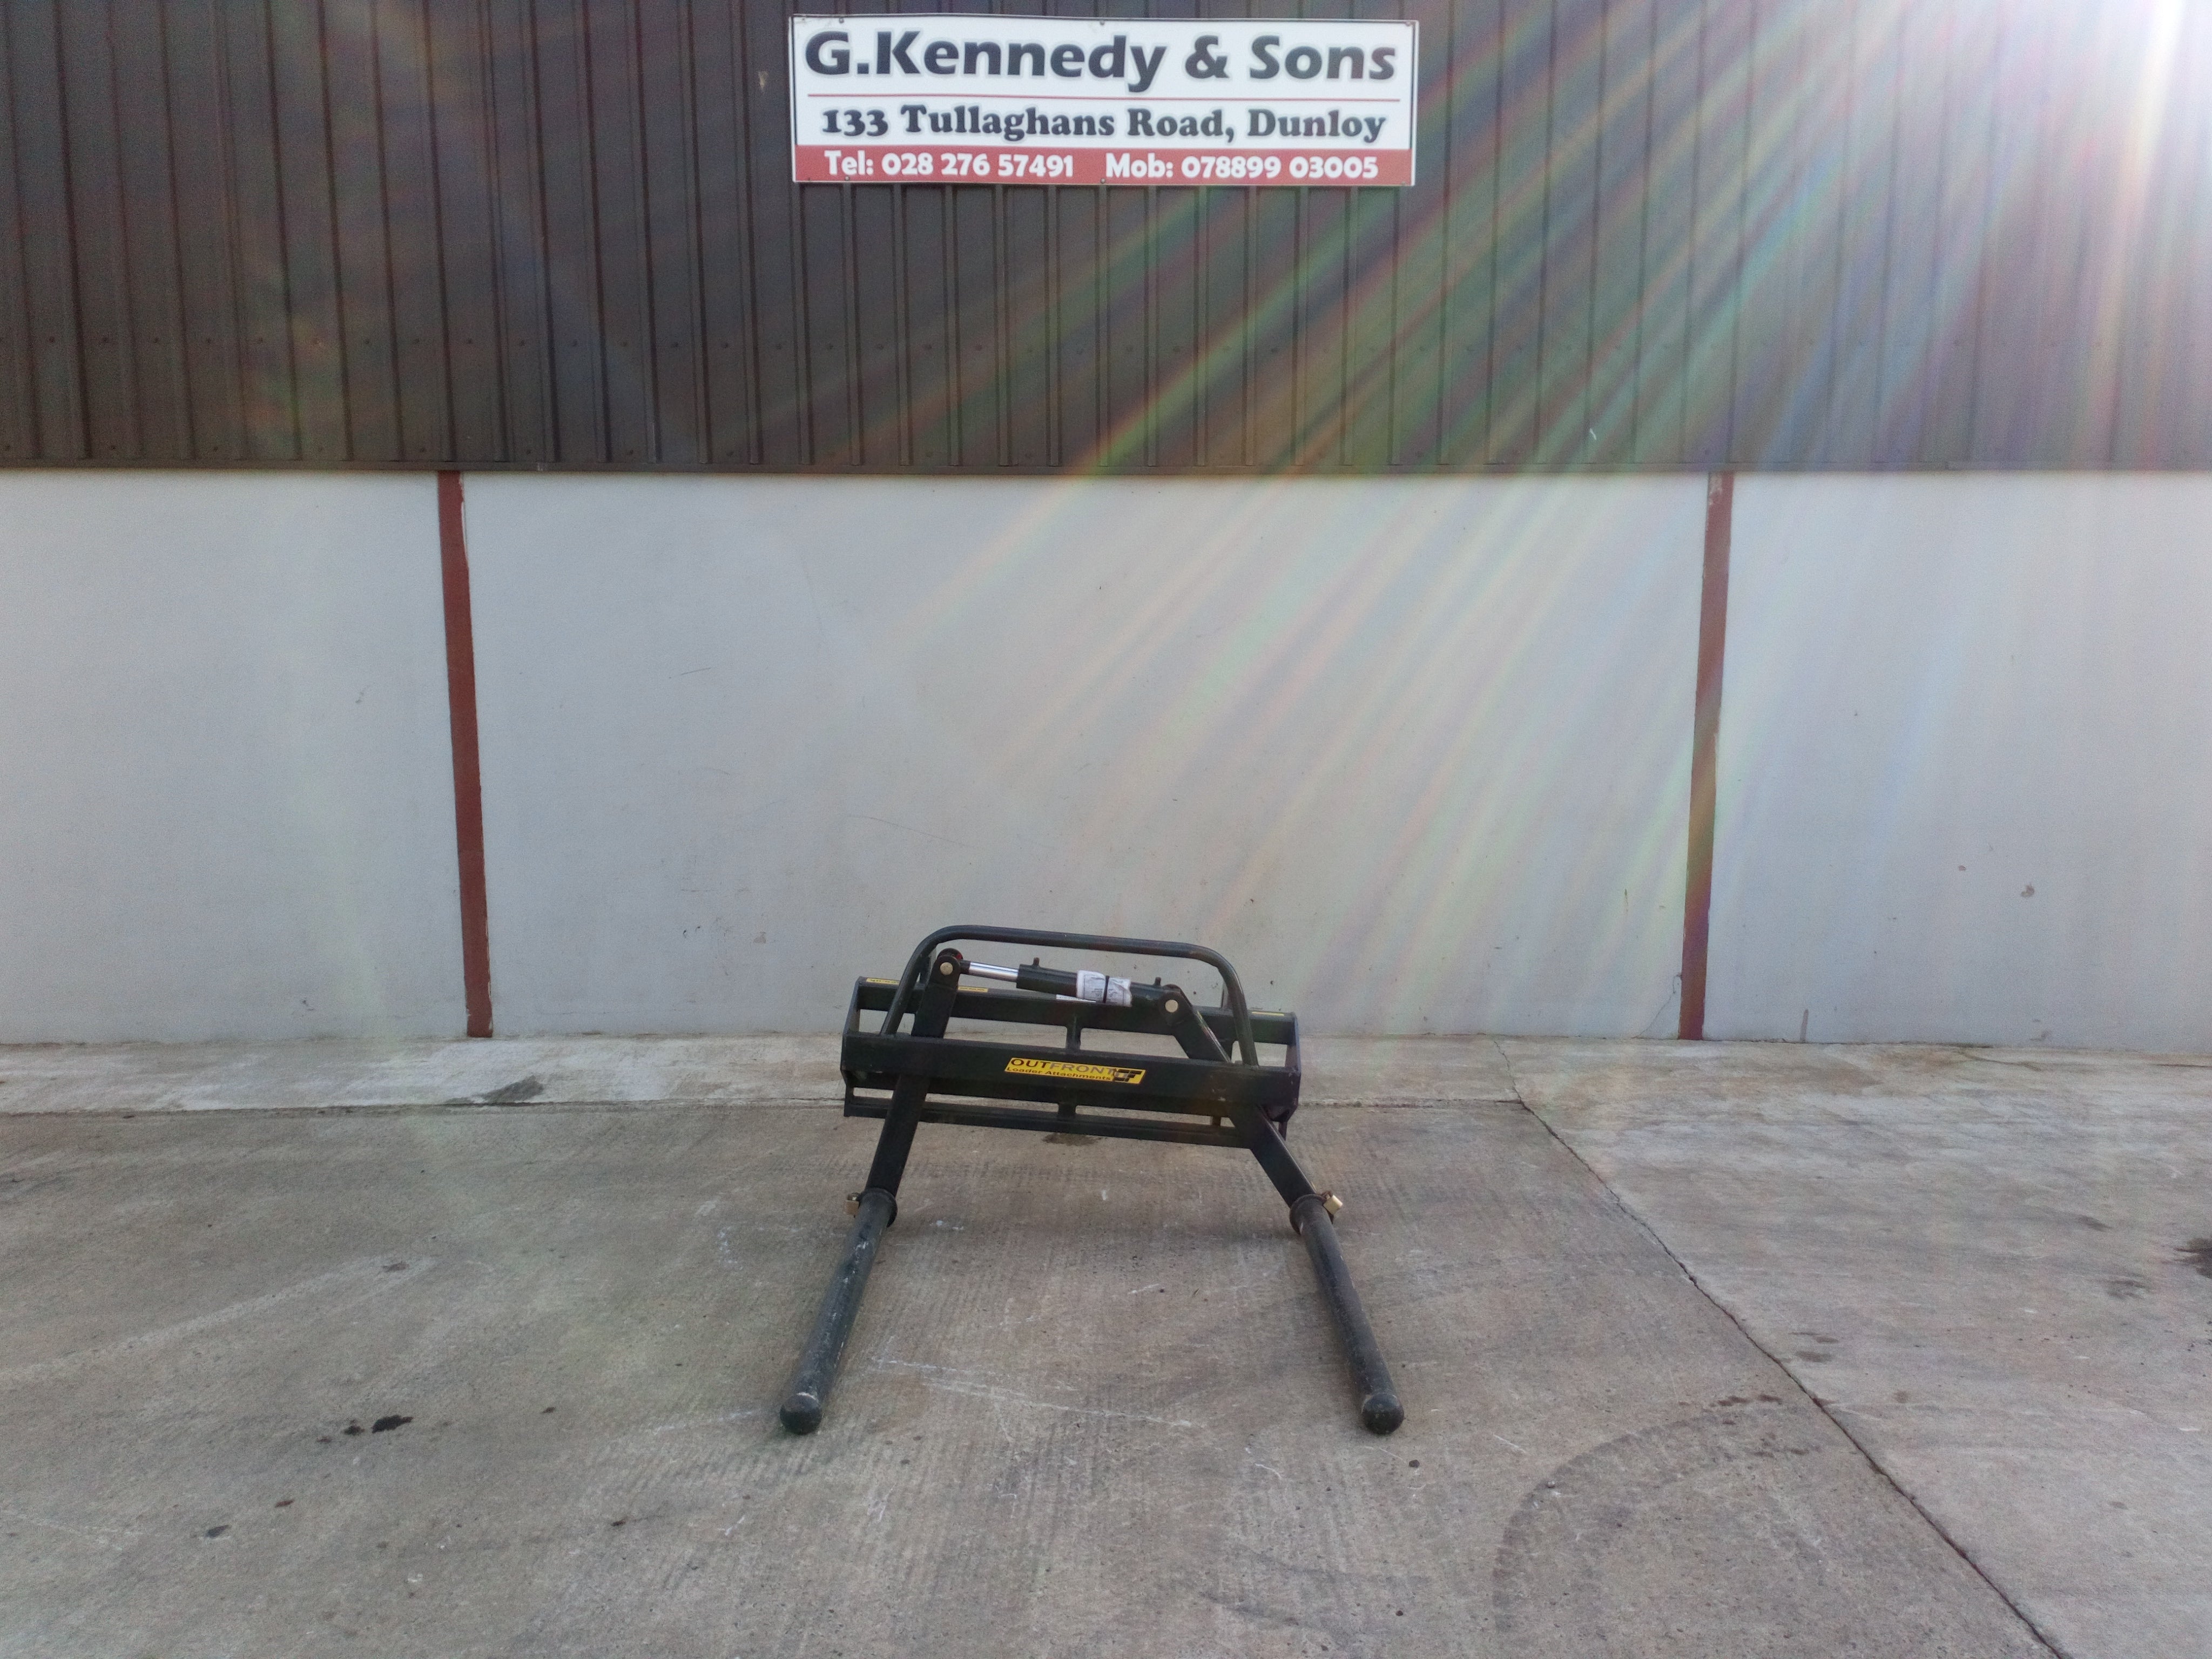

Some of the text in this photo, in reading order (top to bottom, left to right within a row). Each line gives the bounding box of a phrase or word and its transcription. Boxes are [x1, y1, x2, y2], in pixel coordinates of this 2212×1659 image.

[805, 31, 1395, 92] G.Kennedy & Sons
[822, 104, 1386, 143] 133 Tullaghans Road, Dunloy
[824, 150, 1379, 179] Tel: 028 276 57491 Mob: 078899 03005
[1044, 1070, 1111, 1081] Attachments
